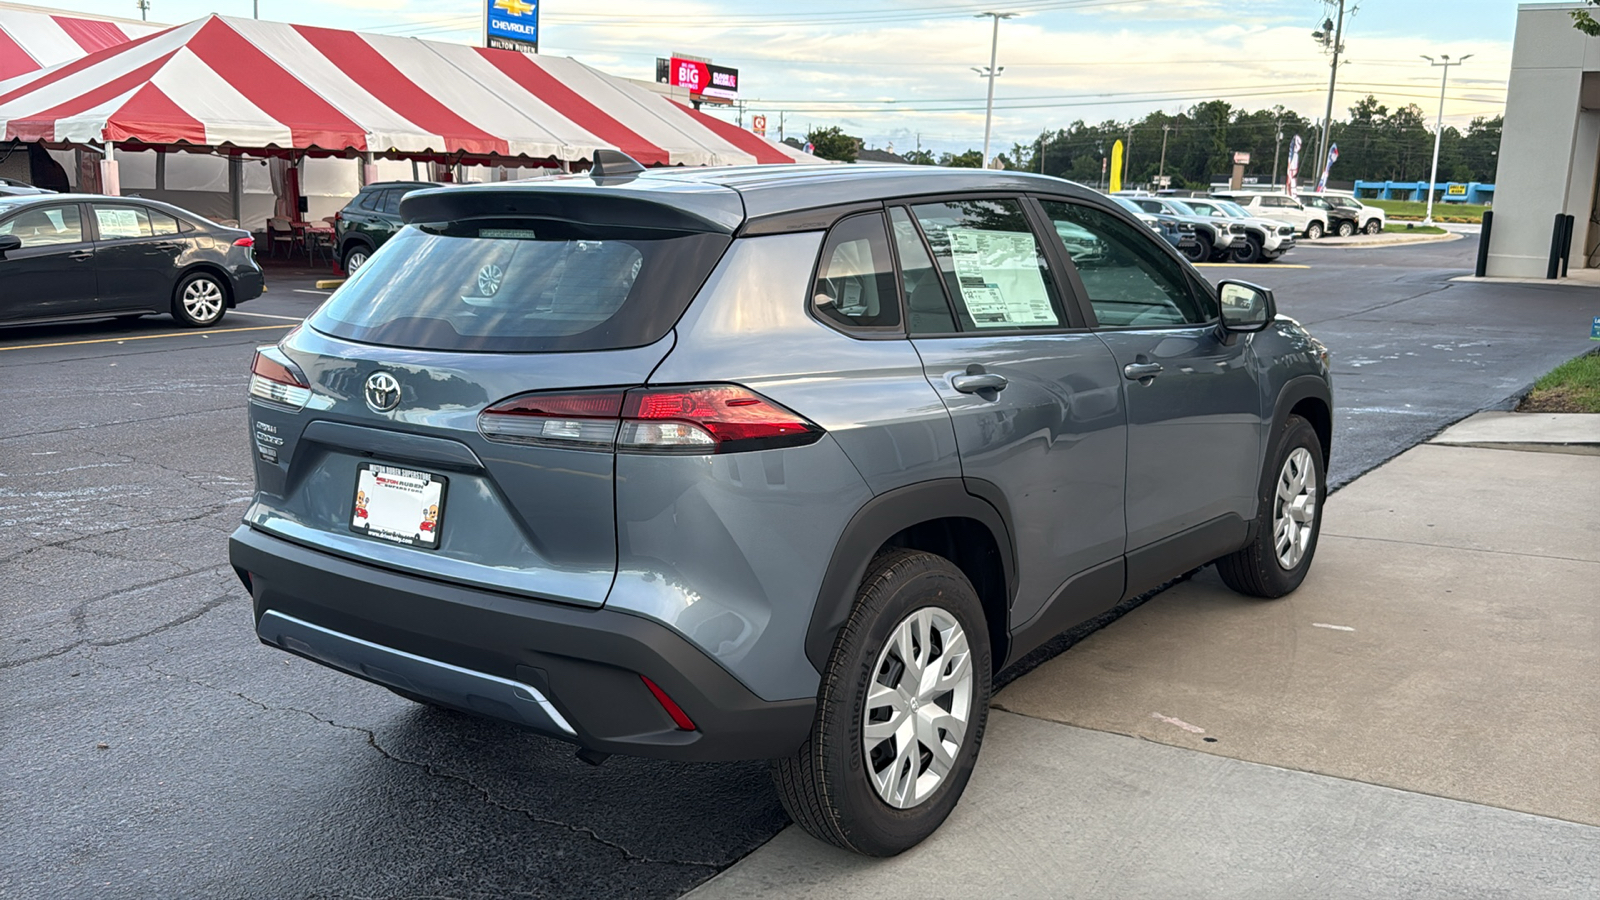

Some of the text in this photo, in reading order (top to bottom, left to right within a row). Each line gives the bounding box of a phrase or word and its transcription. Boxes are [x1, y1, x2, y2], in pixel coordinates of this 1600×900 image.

[492, 19, 535, 35] CHEVROLET
[491, 40, 536, 53] MILTON RUBEN
[679, 67, 699, 84] BIG
[679, 81, 699, 90] SAVINGS
[402, 468, 432, 481] SUPERSTORE
[376, 476, 424, 490] MILTON RUBEN
[384, 483, 423, 494] SUPERSTORE
